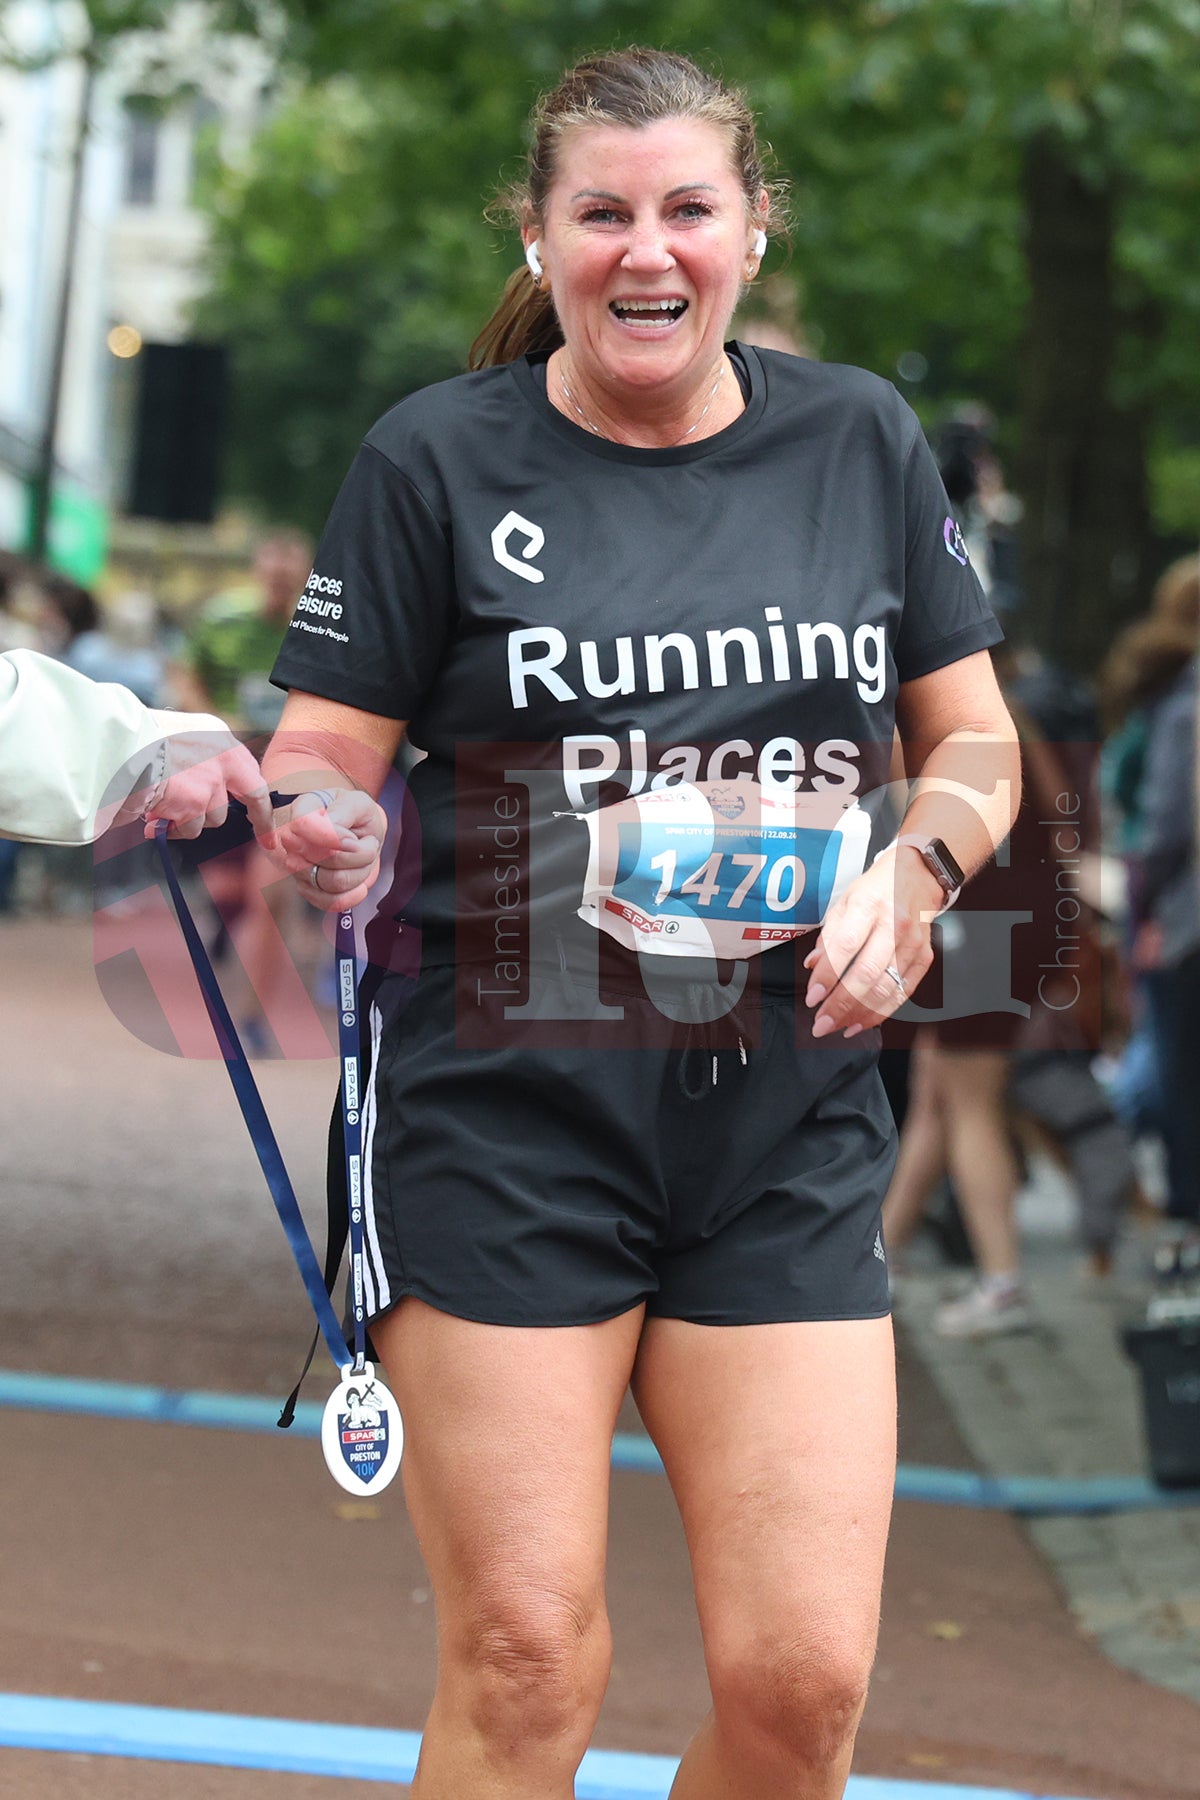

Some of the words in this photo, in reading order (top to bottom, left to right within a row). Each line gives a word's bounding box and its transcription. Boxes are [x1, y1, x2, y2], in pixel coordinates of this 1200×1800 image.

[325, 628, 349, 643] People
[507, 606, 887, 709] Running
[562, 729, 861, 810] Places
[651, 849, 806, 912] 1470
[622, 907, 663, 932] SPAR
[342, 962, 353, 1009] SPAR
[346, 1061, 357, 1108] SPAR
[350, 1159, 360, 1205] SPAR
[355, 1258, 363, 1305] SPAR
[349, 1432, 375, 1441] SPAR
[350, 1451, 380, 1462] PRESTON
[356, 1462, 375, 1476] 10K
